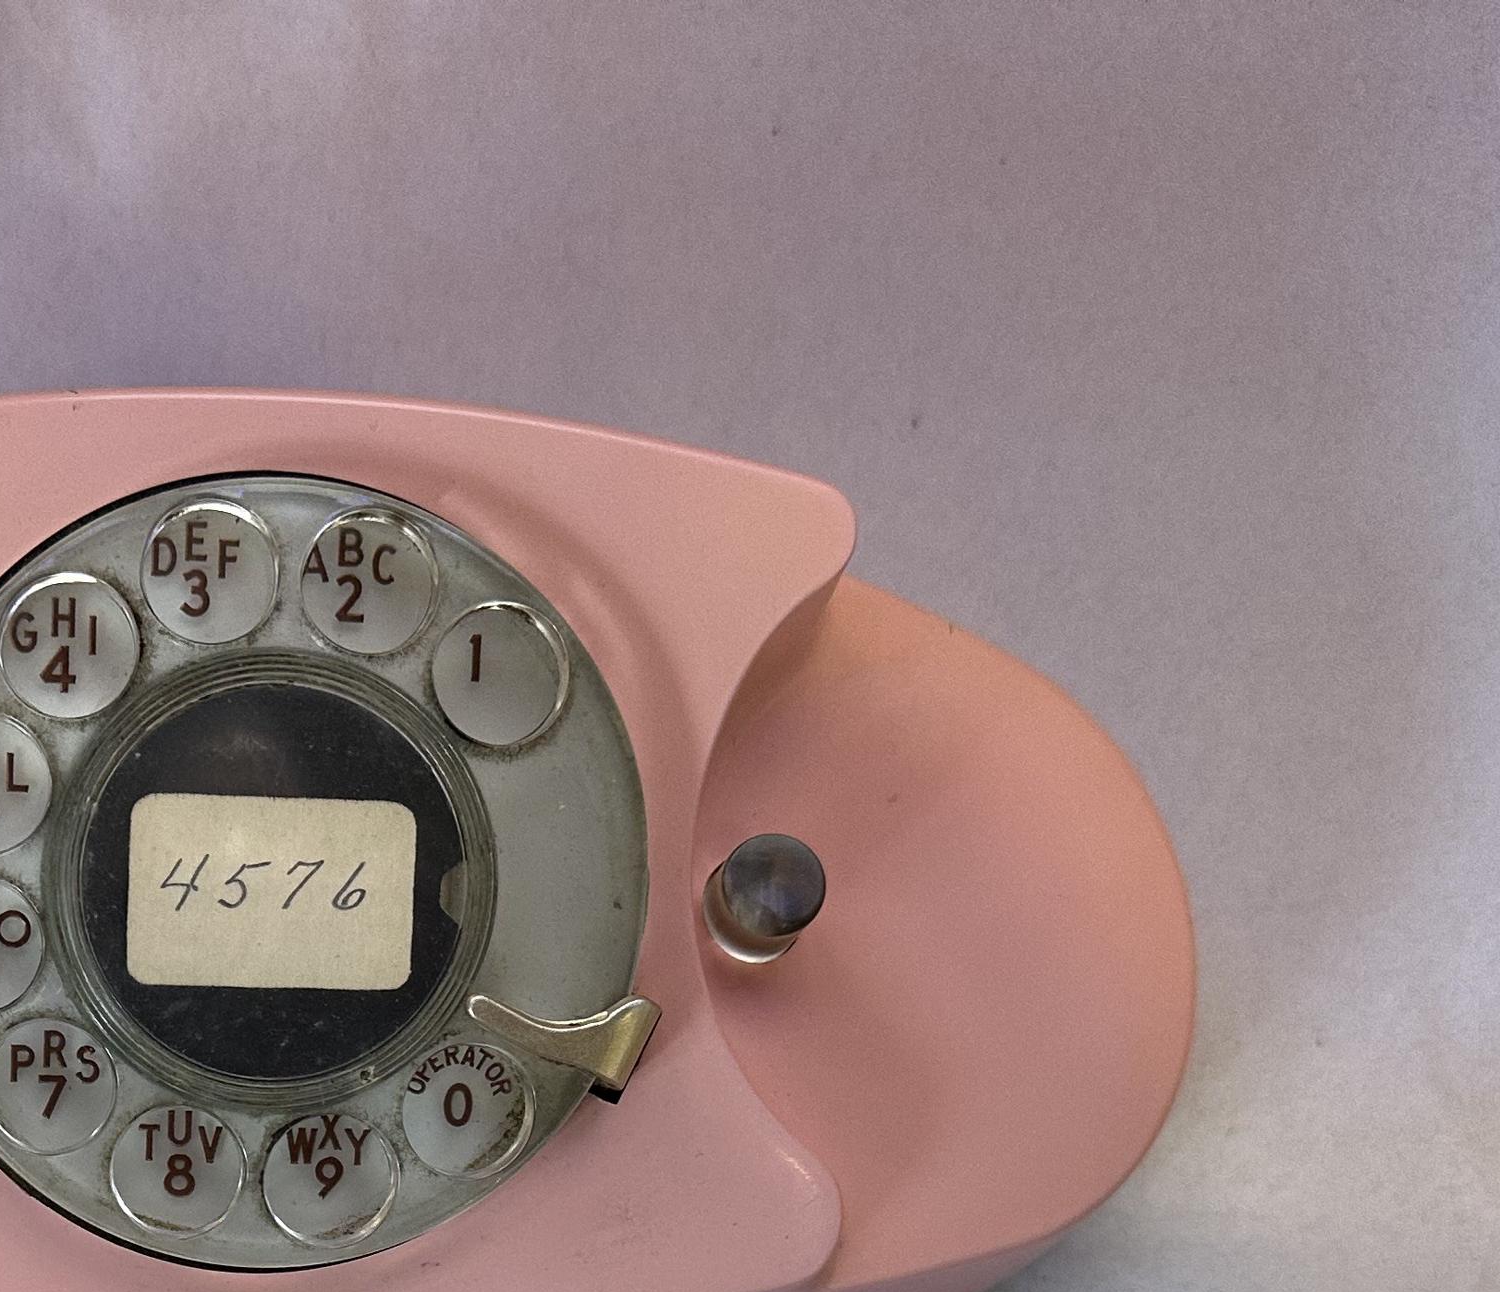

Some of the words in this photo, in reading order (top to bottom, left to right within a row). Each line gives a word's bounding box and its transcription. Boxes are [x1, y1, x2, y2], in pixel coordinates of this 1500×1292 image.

[151, 521, 240, 579] DEF
[304, 526, 398, 584] ABC
[181, 570, 209, 617] 3
[336, 574, 366, 624] 2
[10, 597, 98, 655] GHI
[40, 647, 76, 694] 4
[469, 633, 484, 683] 1
[160, 853, 366, 911] 4576
[10, 1031, 100, 1083] PRS
[407, 1045, 514, 1096] OPERATOR
[37, 1074, 67, 1119] 7
[444, 1083, 473, 1126] 0
[140, 1110, 222, 1163] TUV
[288, 1114, 368, 1165] WXY
[164, 1153, 196, 1199] 8
[314, 1157, 345, 1198] 9
